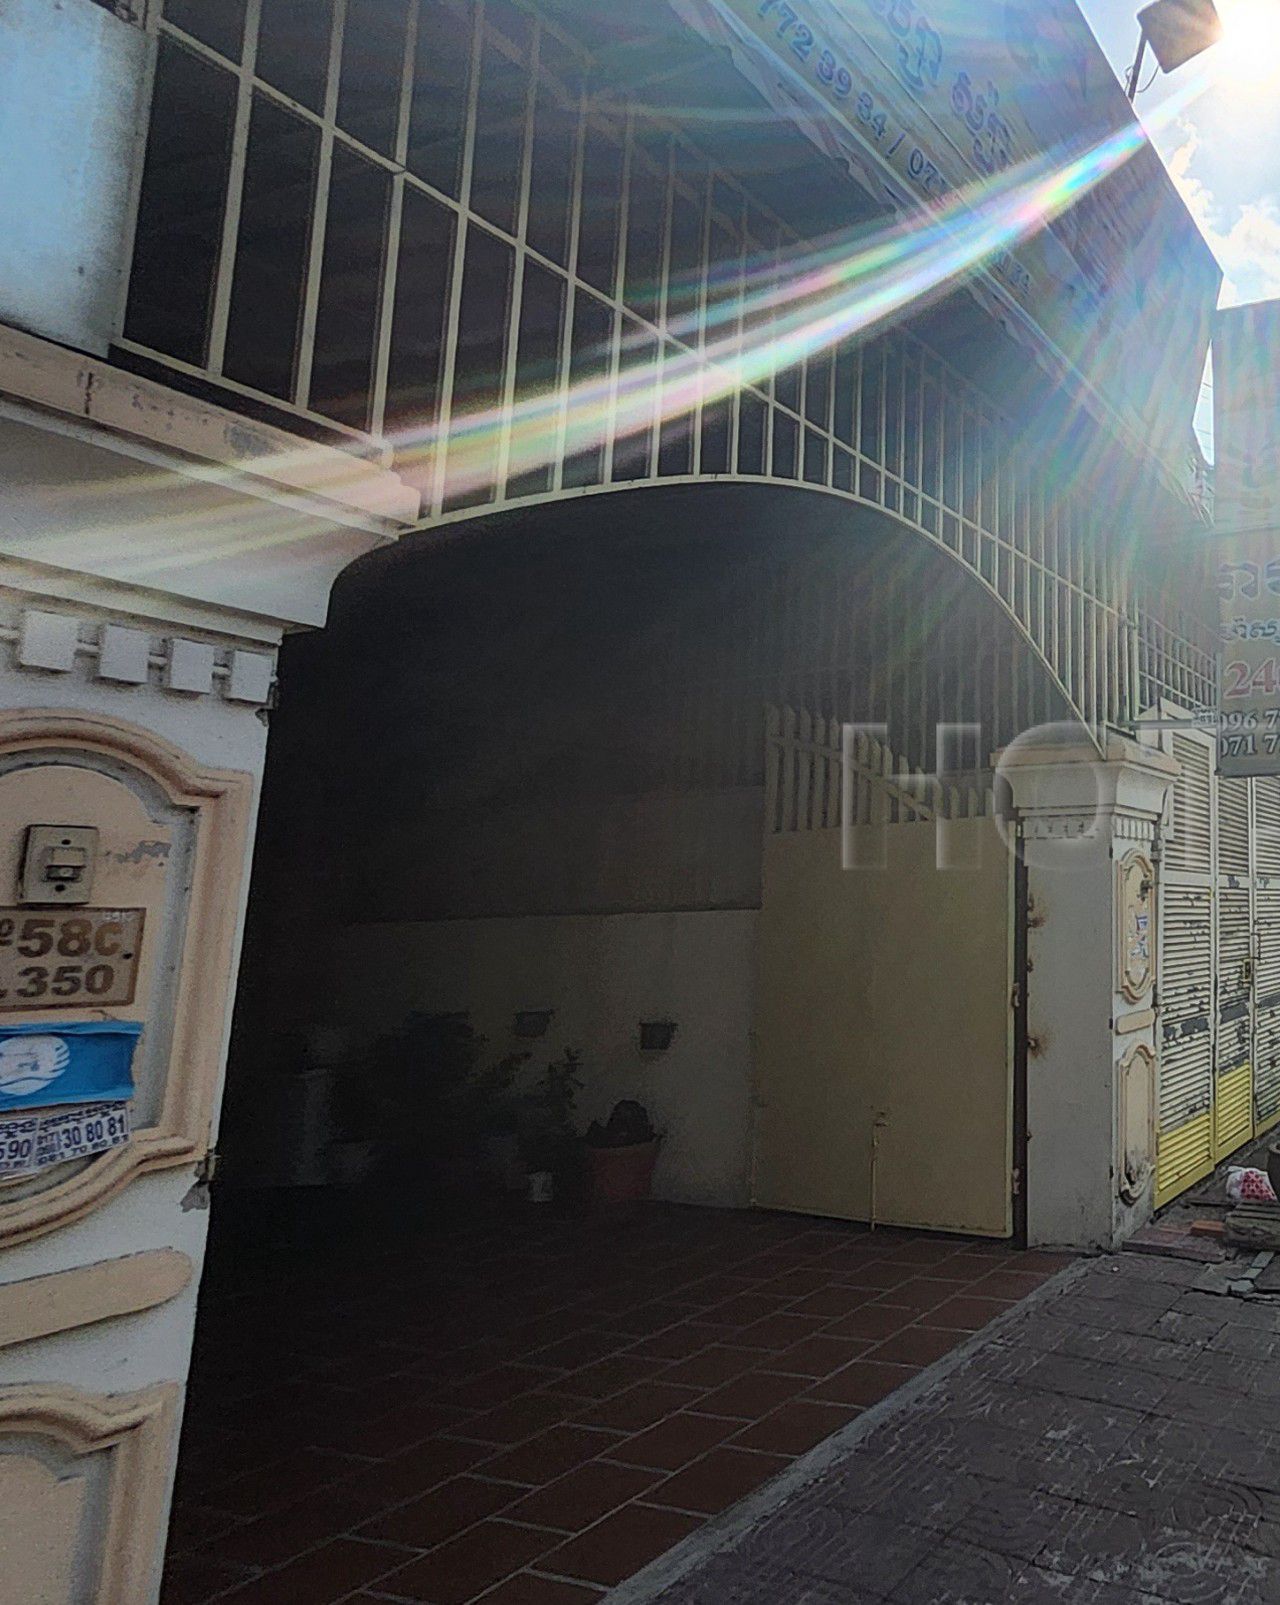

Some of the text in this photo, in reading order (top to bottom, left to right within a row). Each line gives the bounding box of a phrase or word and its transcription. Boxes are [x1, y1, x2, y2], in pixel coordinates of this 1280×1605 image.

[815, 48, 853, 97] 39
[62, 1125, 81, 1149] 30
[85, 1120, 103, 1143] 80
[107, 1114, 125, 1136] 81
